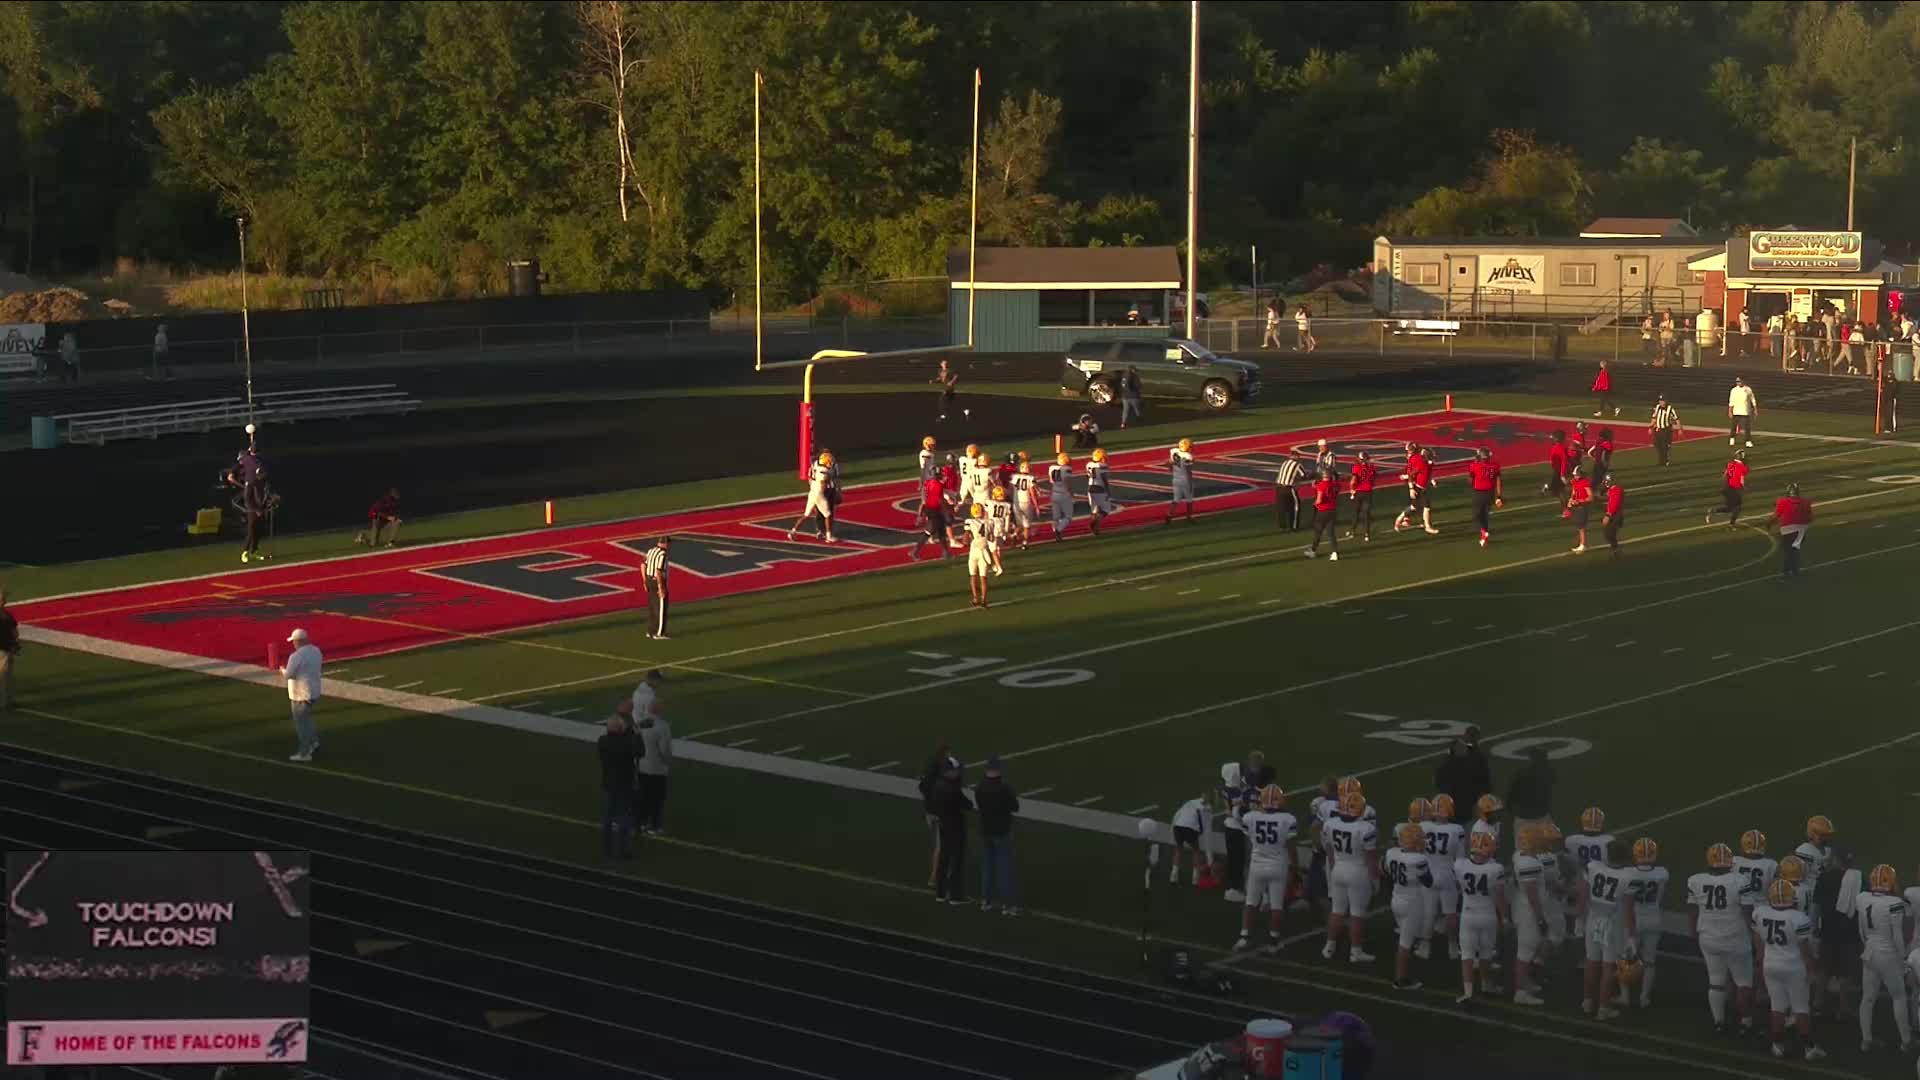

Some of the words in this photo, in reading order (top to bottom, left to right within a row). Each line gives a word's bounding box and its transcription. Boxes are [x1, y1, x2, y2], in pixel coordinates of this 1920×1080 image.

[1487, 266, 1536, 284] HIVELY
[907, 657, 1096, 688] 10
[1256, 821, 1279, 844] 55
[1332, 830, 1353, 854] 57
[1425, 832, 1449, 855] 37
[1464, 873, 1489, 896] 34
[1592, 873, 1619, 902] 87
[1703, 885, 1727, 910] 78
[1763, 919, 1788, 946] 75
